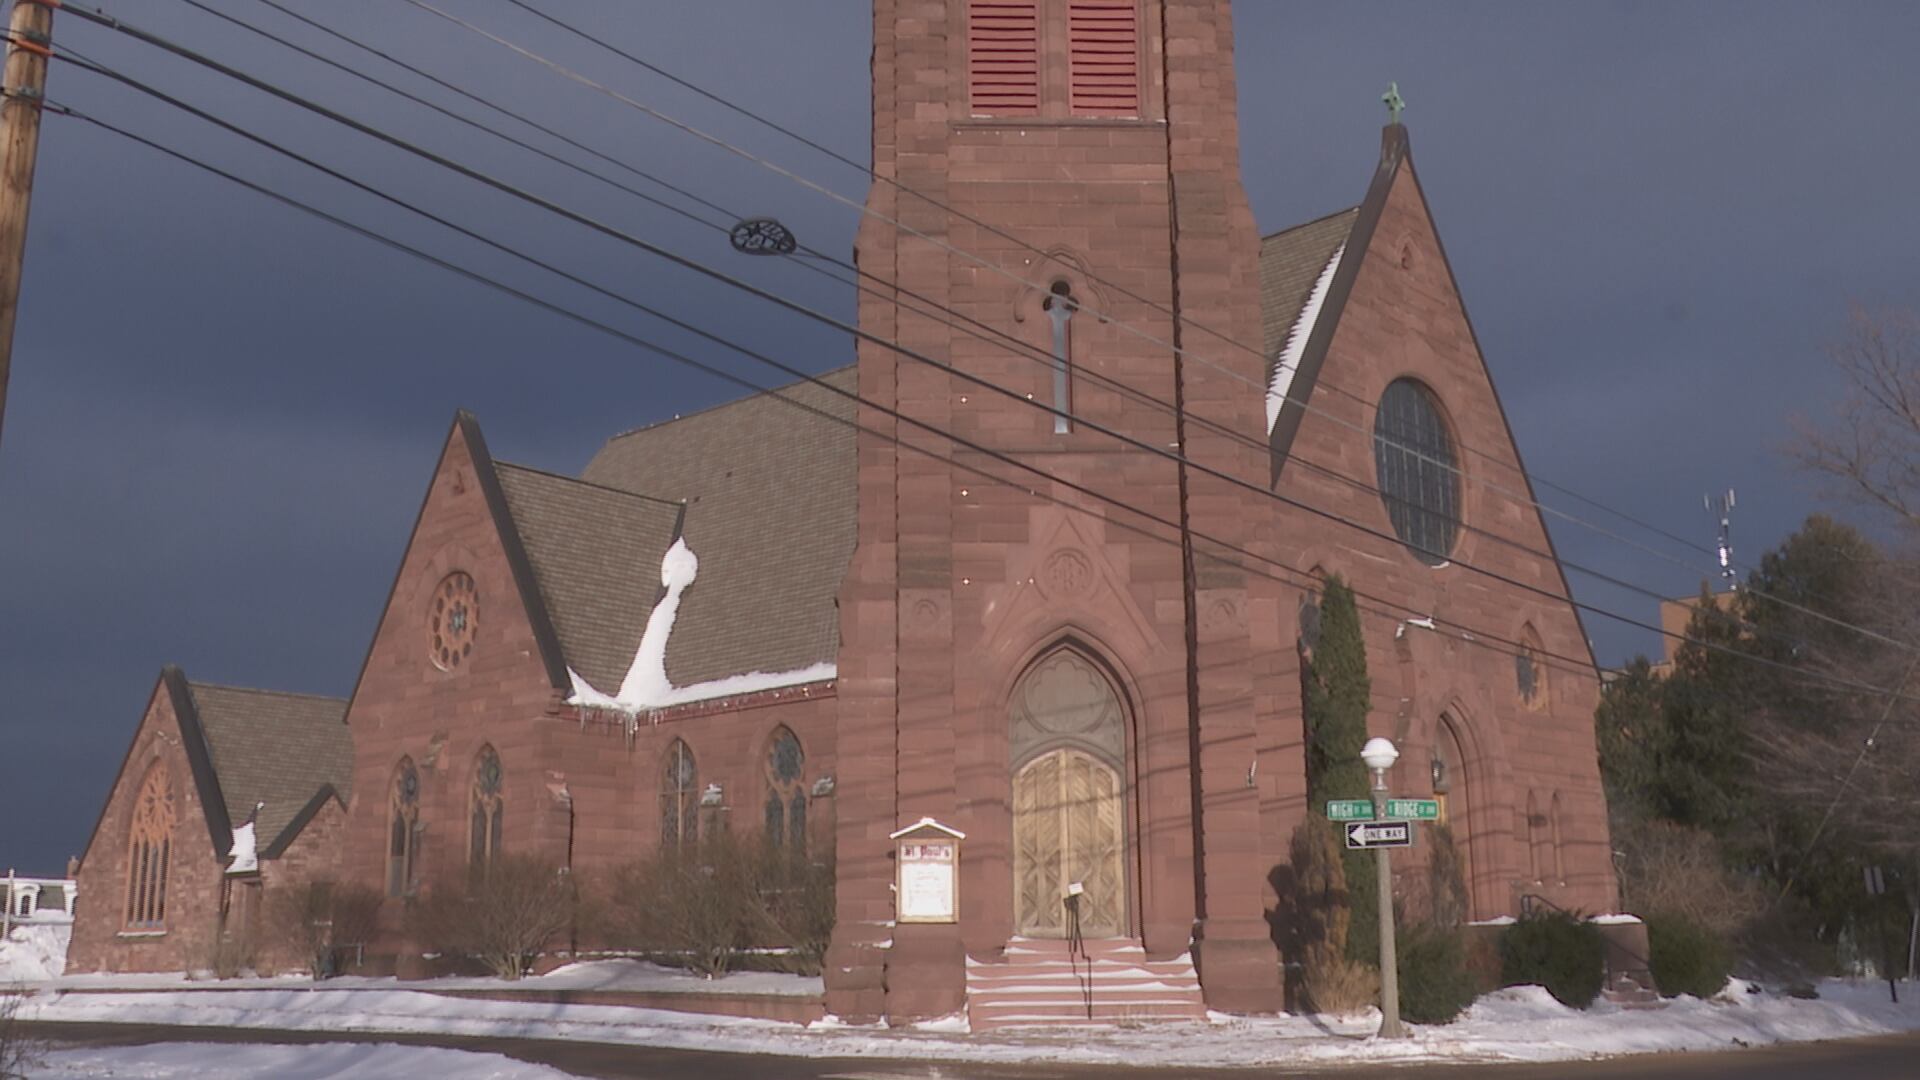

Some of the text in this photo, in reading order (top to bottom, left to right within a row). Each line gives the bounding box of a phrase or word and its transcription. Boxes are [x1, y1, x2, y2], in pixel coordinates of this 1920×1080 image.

[1394, 802, 1418, 816] RIDGE
[1365, 828, 1402, 839] ONE WAY
